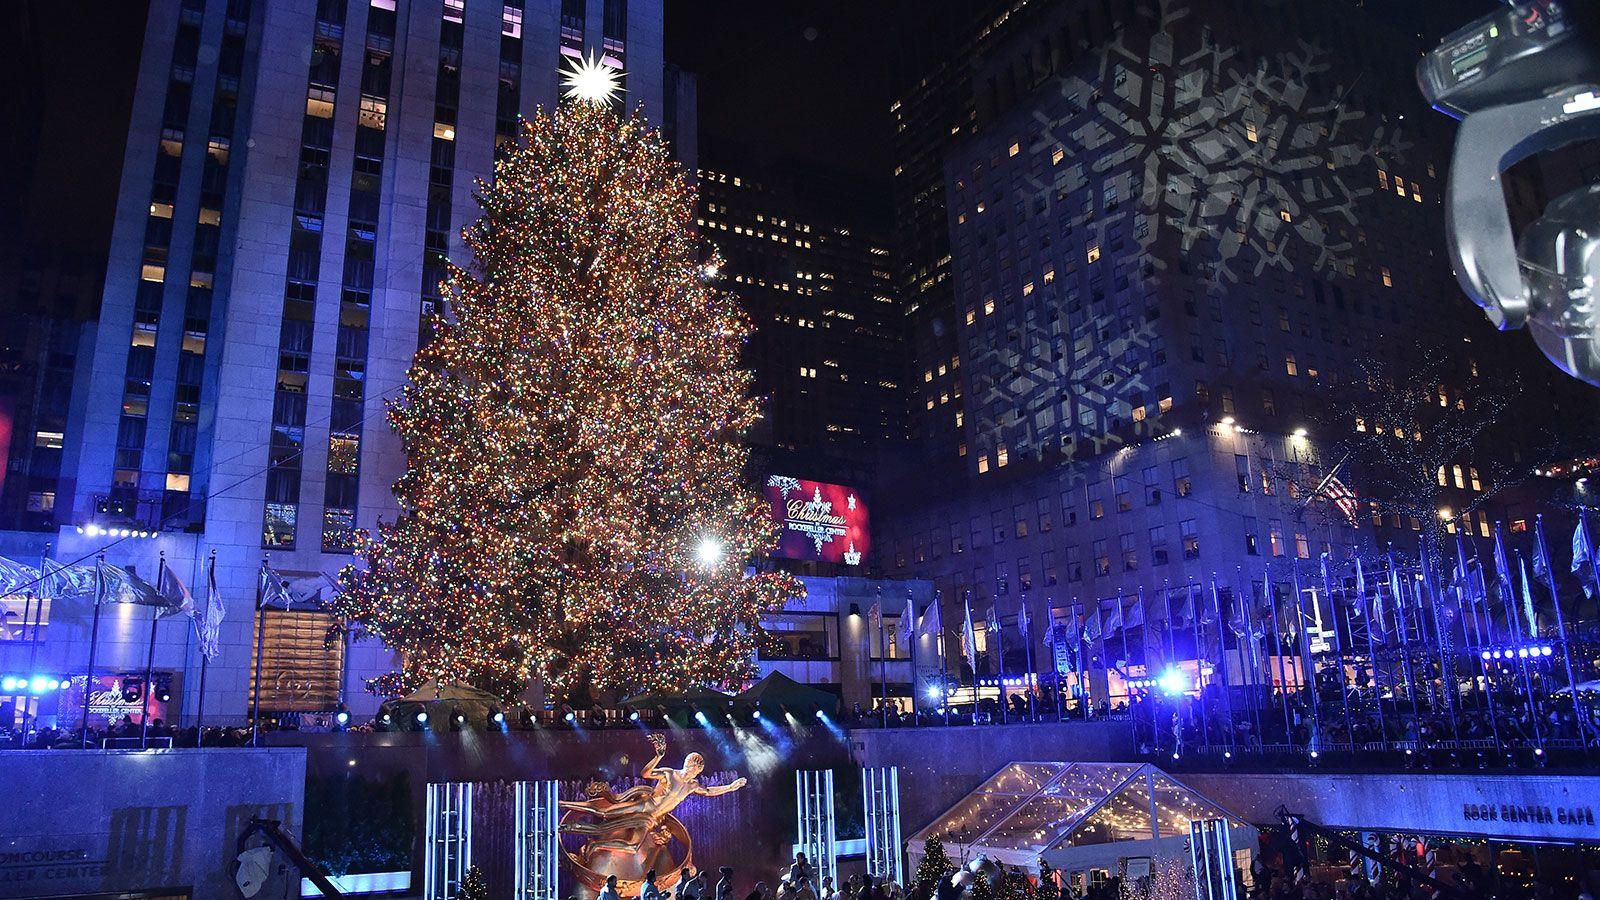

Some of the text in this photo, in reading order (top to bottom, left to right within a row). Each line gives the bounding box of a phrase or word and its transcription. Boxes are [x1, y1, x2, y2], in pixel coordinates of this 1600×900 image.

[786, 499, 847, 525] Christmas
[1463, 805, 1498, 821] ROCK
[1500, 805, 1554, 825] CENTER
